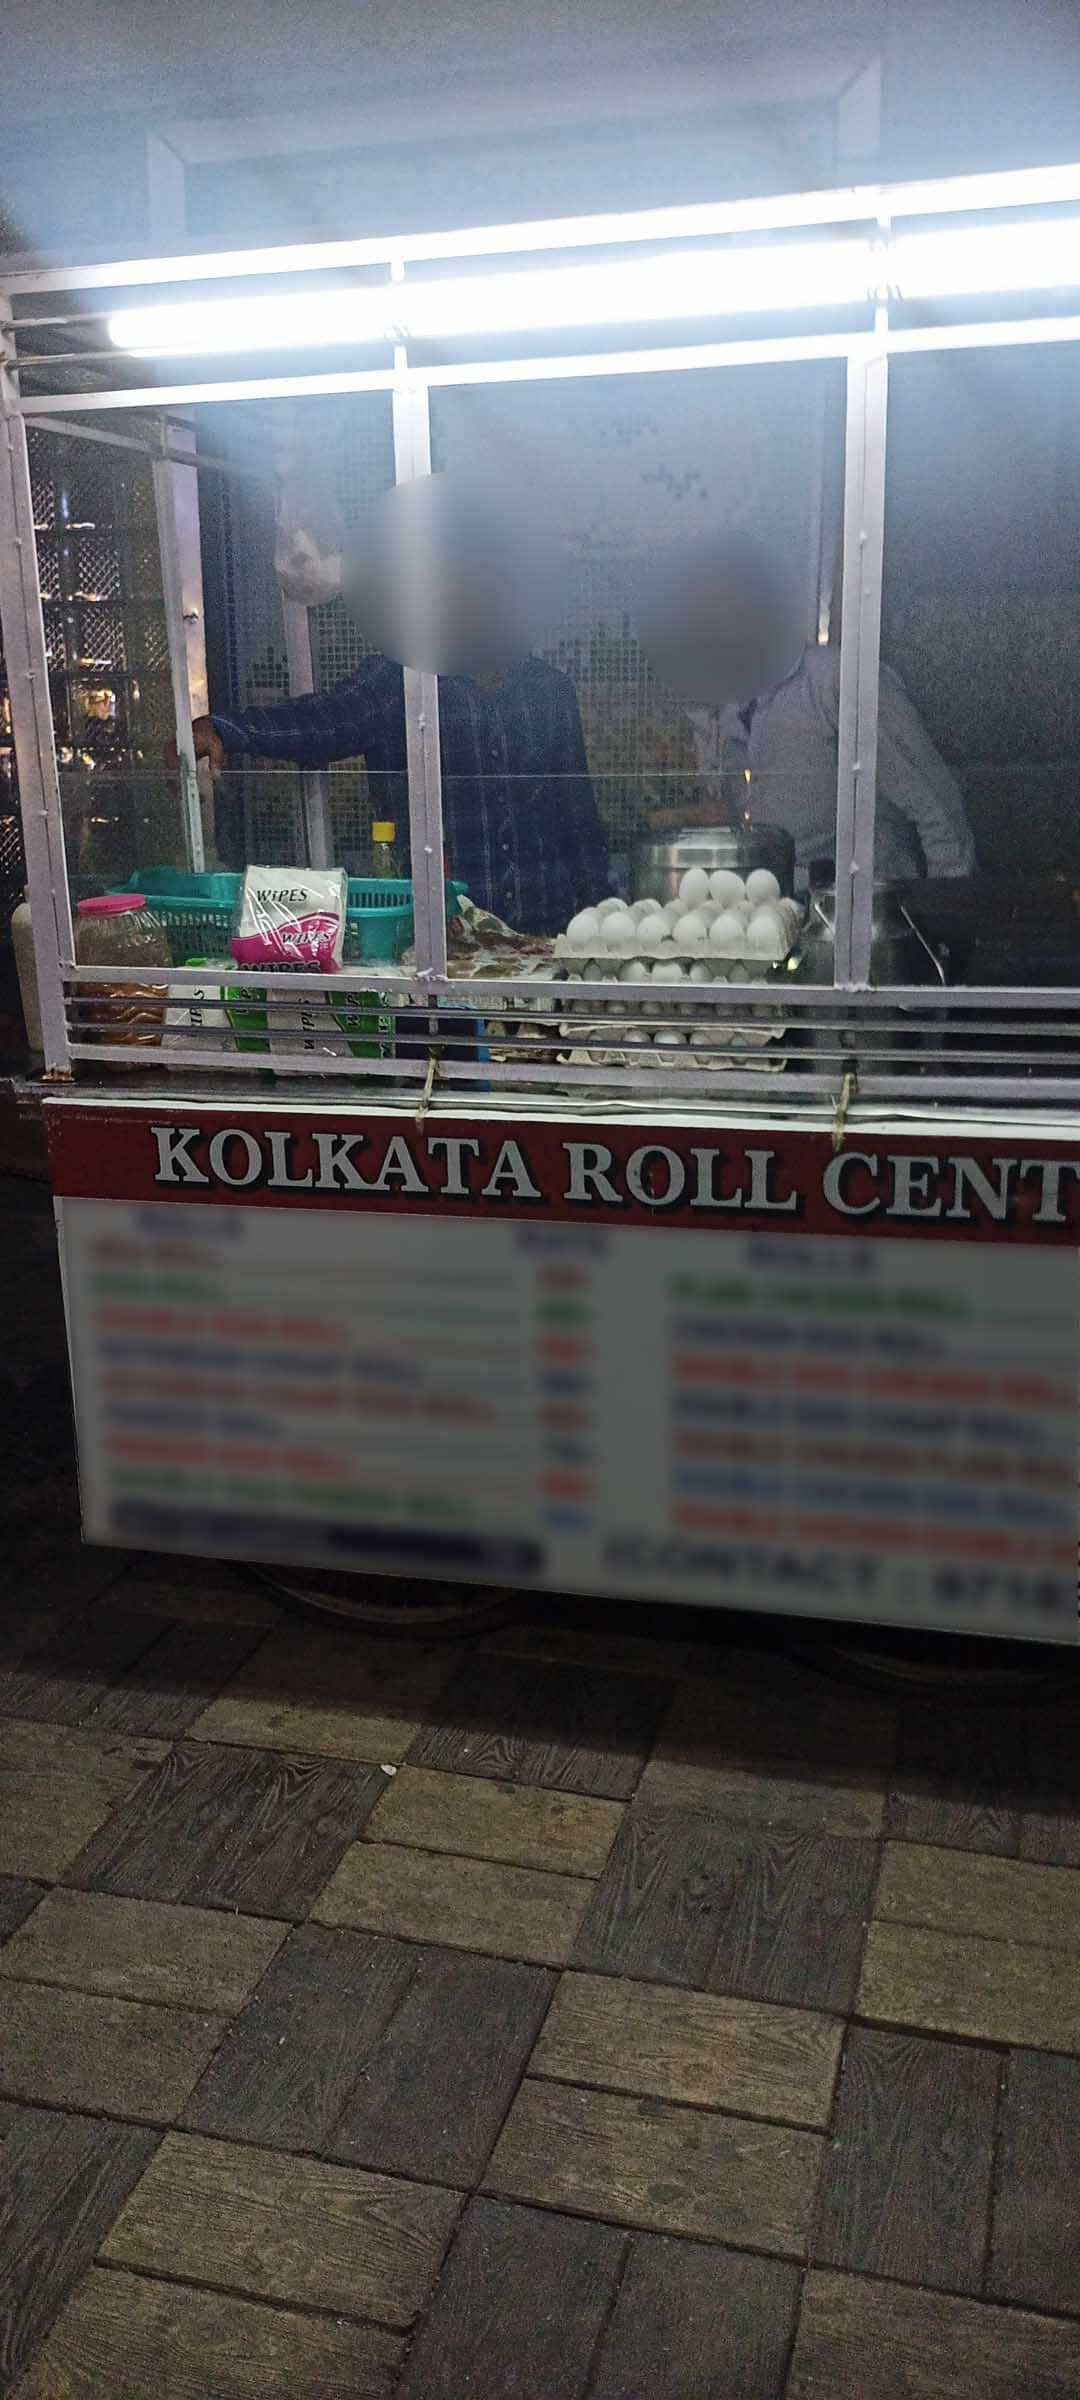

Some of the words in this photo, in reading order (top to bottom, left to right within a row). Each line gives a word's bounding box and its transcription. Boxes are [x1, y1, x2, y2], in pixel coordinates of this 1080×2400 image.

[150, 1126, 541, 1199] KOLKATA
[561, 1141, 799, 1211] ROLL
[822, 1150, 1080, 1223] CENT
